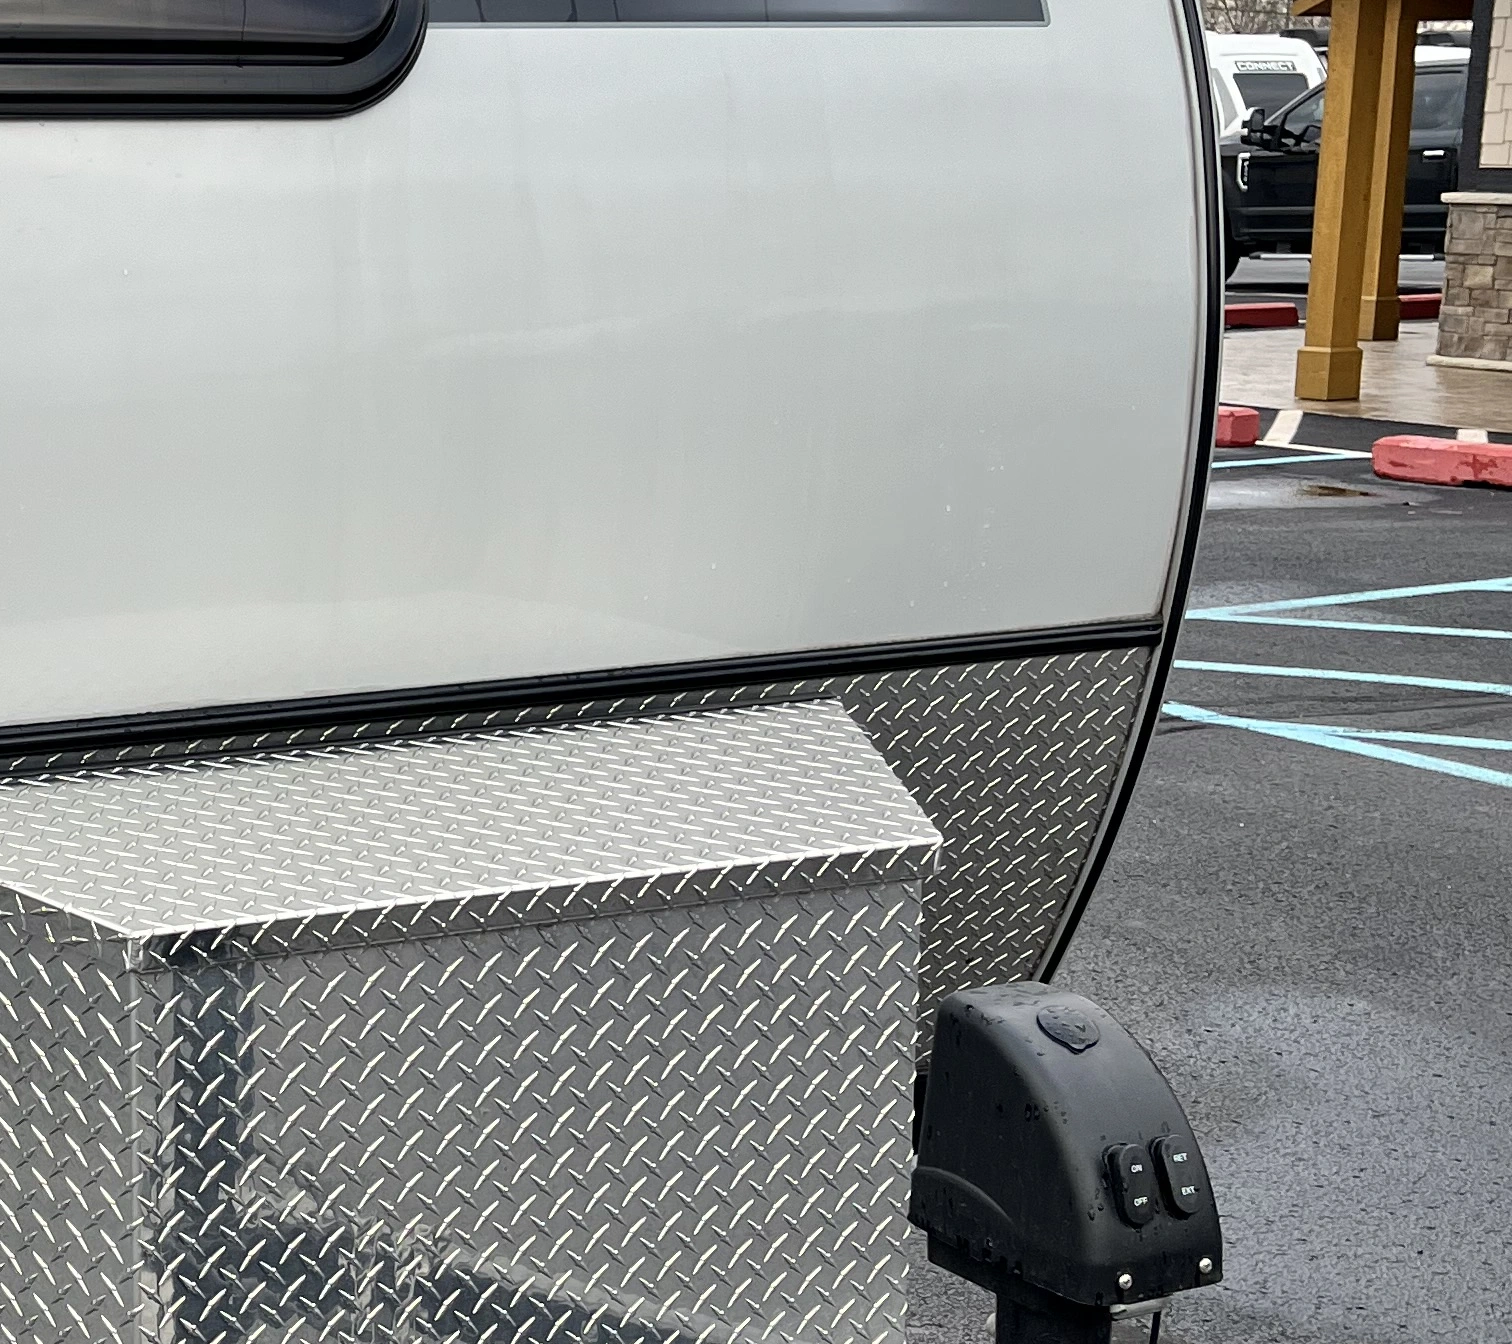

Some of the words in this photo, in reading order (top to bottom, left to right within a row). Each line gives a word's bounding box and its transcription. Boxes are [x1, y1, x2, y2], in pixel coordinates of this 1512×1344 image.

[1235, 61, 1296, 71] CONNECT
[1131, 1164, 1143, 1173] ON
[1181, 1185, 1195, 1196] EXT
[1134, 1196, 1148, 1207] OFF
